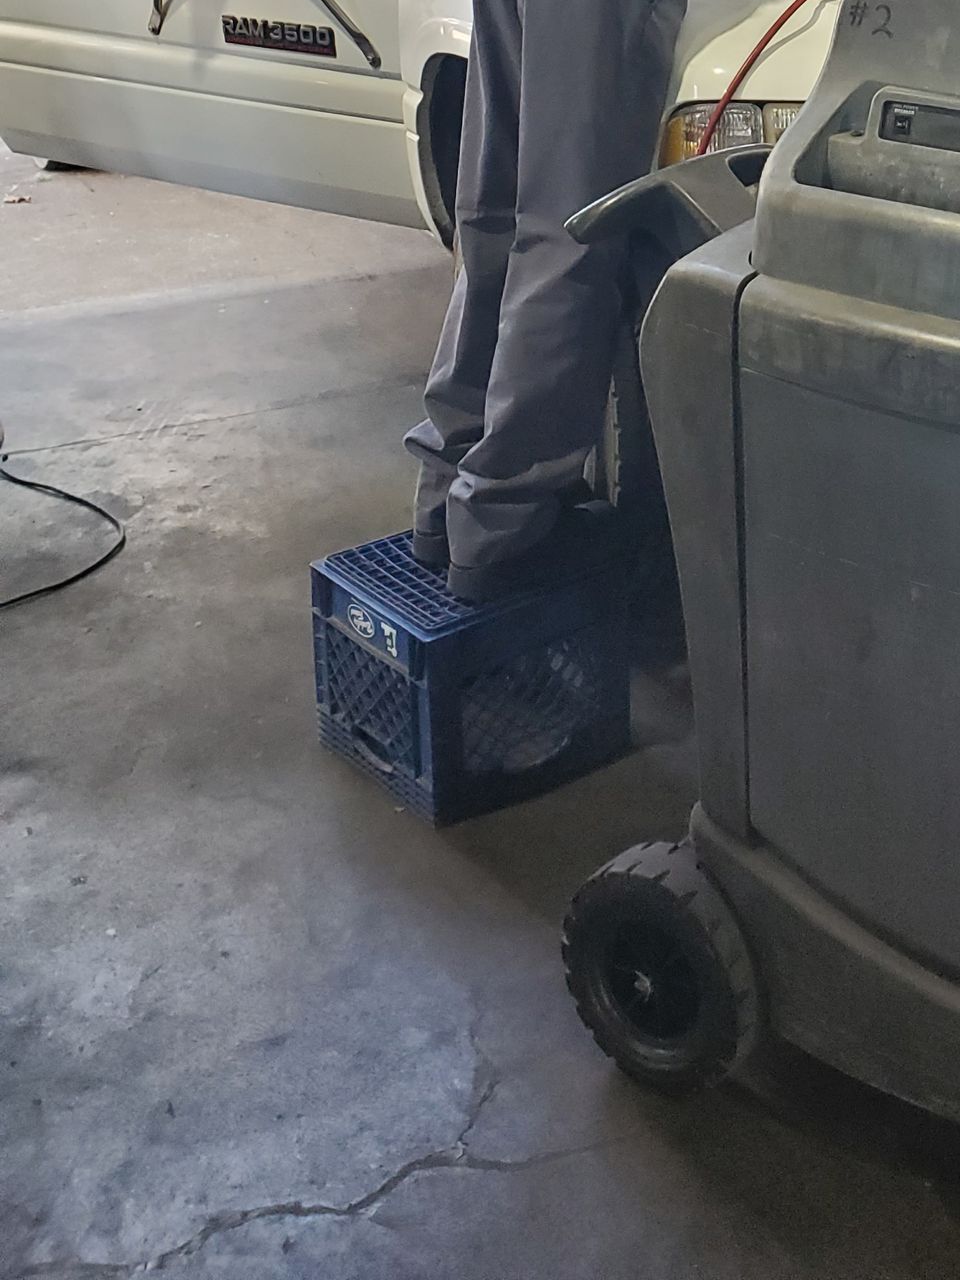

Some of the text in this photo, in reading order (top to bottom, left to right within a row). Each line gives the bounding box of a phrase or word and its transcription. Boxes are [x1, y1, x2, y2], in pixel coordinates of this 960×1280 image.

[222, 16, 332, 46] RAM 3500
[849, 0, 894, 38] #2
